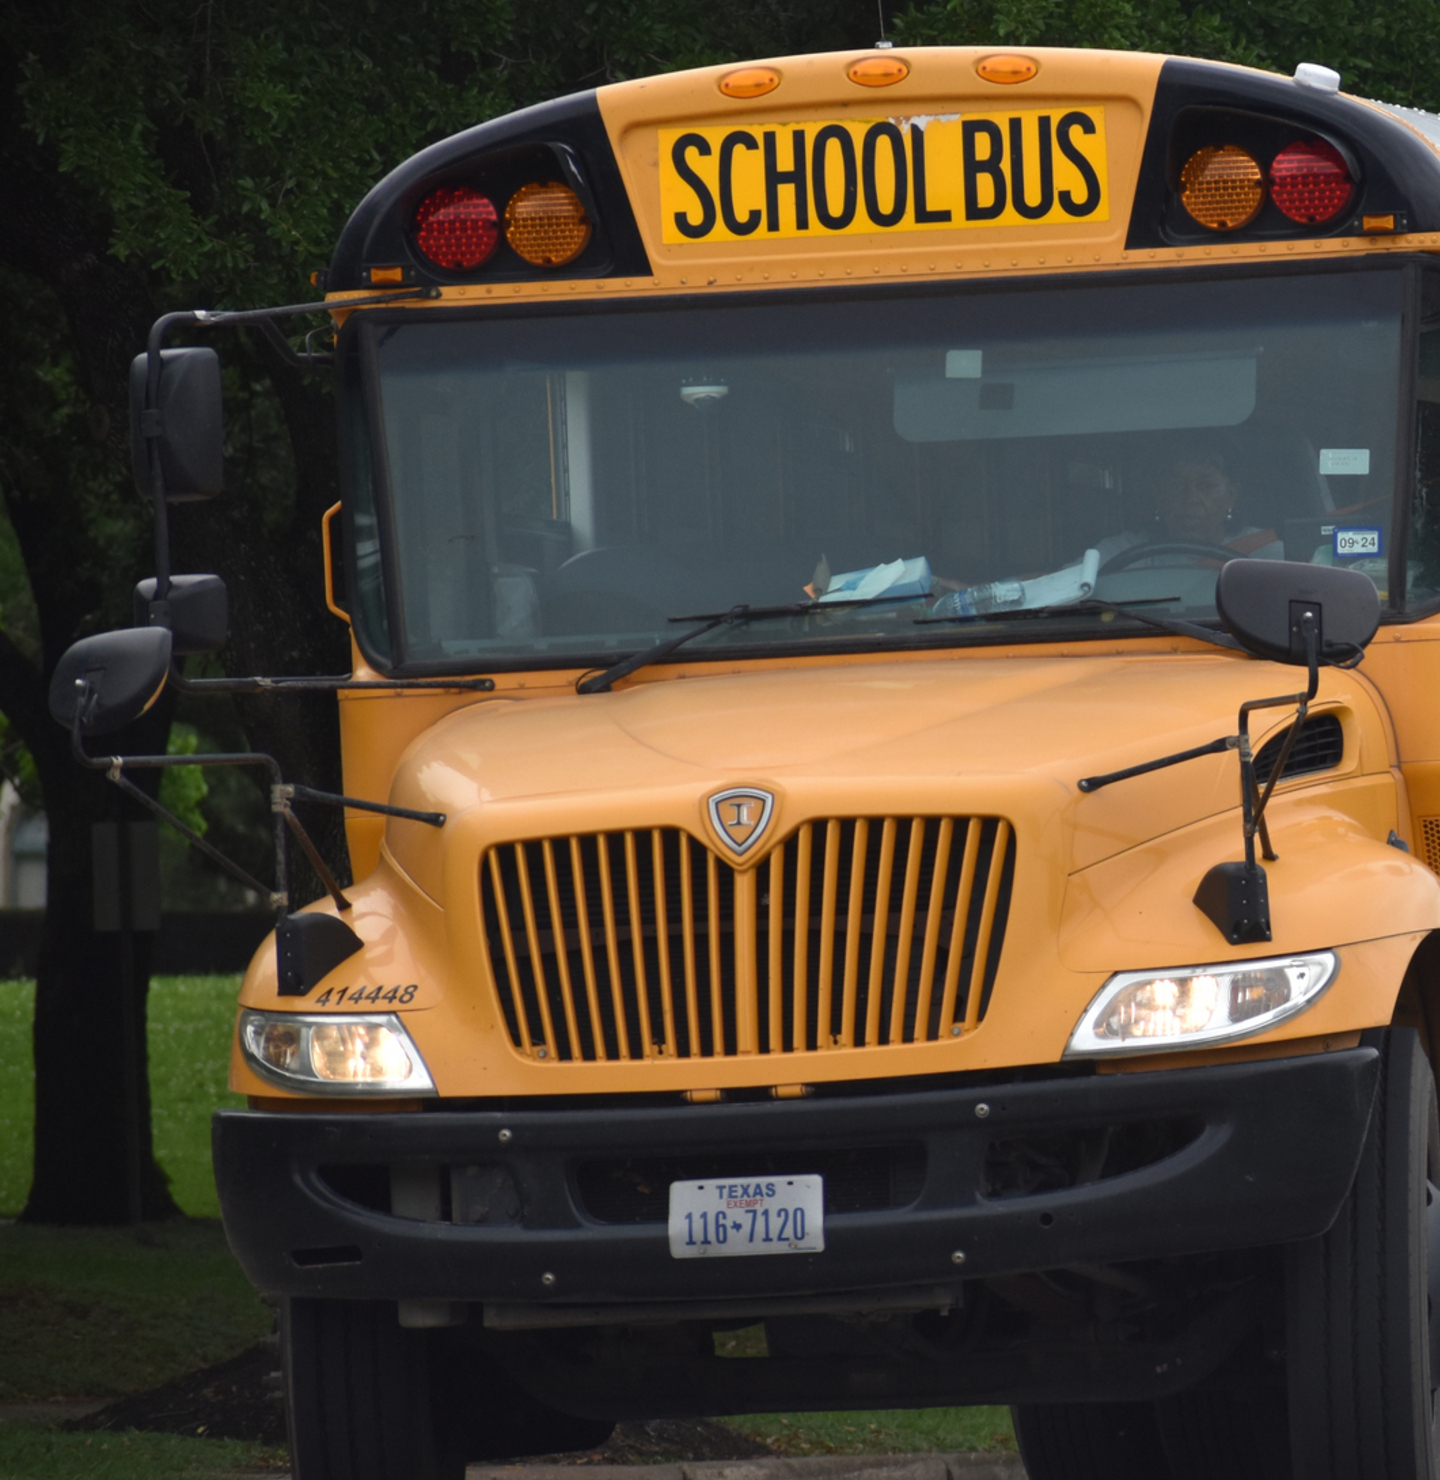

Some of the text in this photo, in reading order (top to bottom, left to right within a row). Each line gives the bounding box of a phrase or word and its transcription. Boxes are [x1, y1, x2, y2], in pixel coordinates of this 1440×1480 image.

[671, 111, 1101, 239] SCHOOL BUS
[315, 984, 419, 1007] 414448
[715, 1183, 776, 1200] TEXAS
[726, 1198, 765, 1209] EXEMPT
